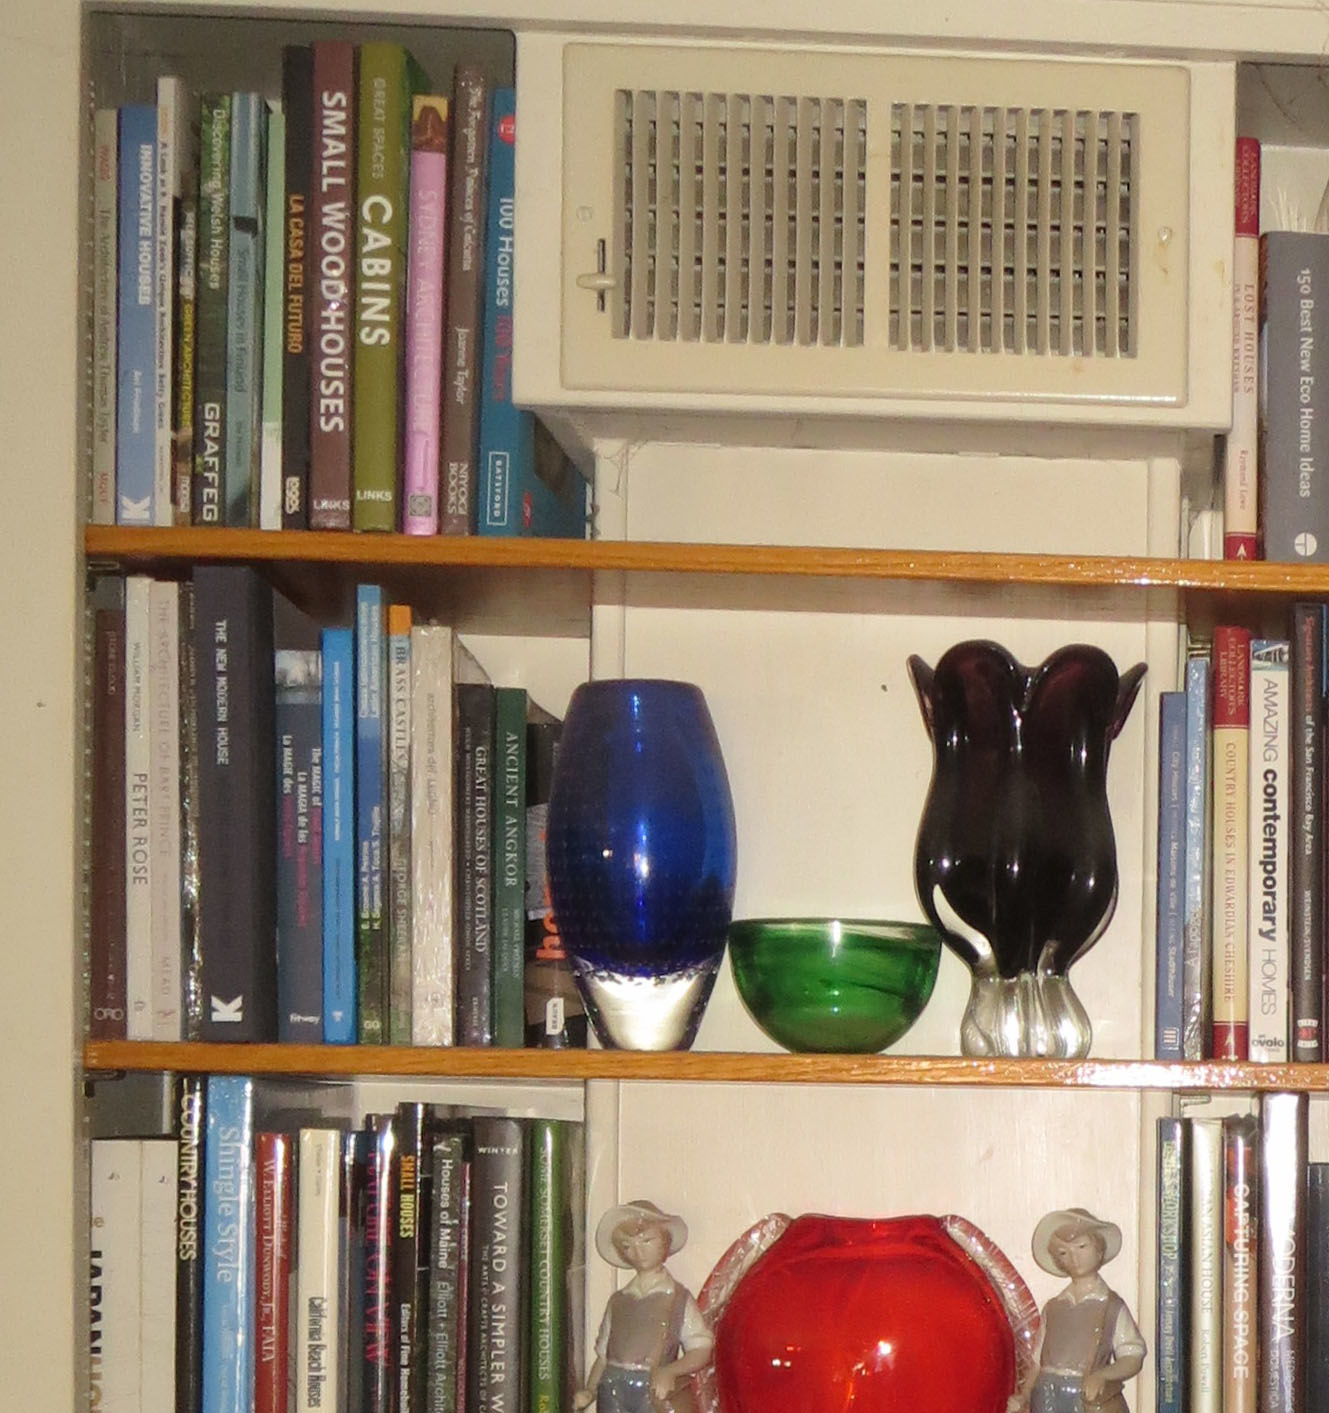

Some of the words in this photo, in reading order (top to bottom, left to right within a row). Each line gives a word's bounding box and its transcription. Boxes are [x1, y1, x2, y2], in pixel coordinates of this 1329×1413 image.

[322, 92, 346, 191] SMALL
[320, 202, 345, 301] WOOD
[359, 194, 393, 345] CABINS
[1297, 268, 1313, 294] 150
[1300, 299, 1313, 332] Best
[318, 310, 345, 431] HOUSES
[1300, 337, 1313, 372] New
[1300, 377, 1313, 404] Eco
[203, 403, 220, 521] GRAFFEG
[1300, 408, 1313, 452] Home
[1299, 457, 1313, 497] Ideas
[1263, 679, 1279, 761] AMAZING
[132, 773, 148, 829] PETER
[132, 836, 148, 885] ROSE
[1258, 768, 1280, 941] contemporary
[1262, 948, 1276, 1015] HOMES
[491, 1182, 508, 1272] TOWARD
[492, 1282, 507, 1294] A
[491, 1304, 507, 1384] SIMPLER
